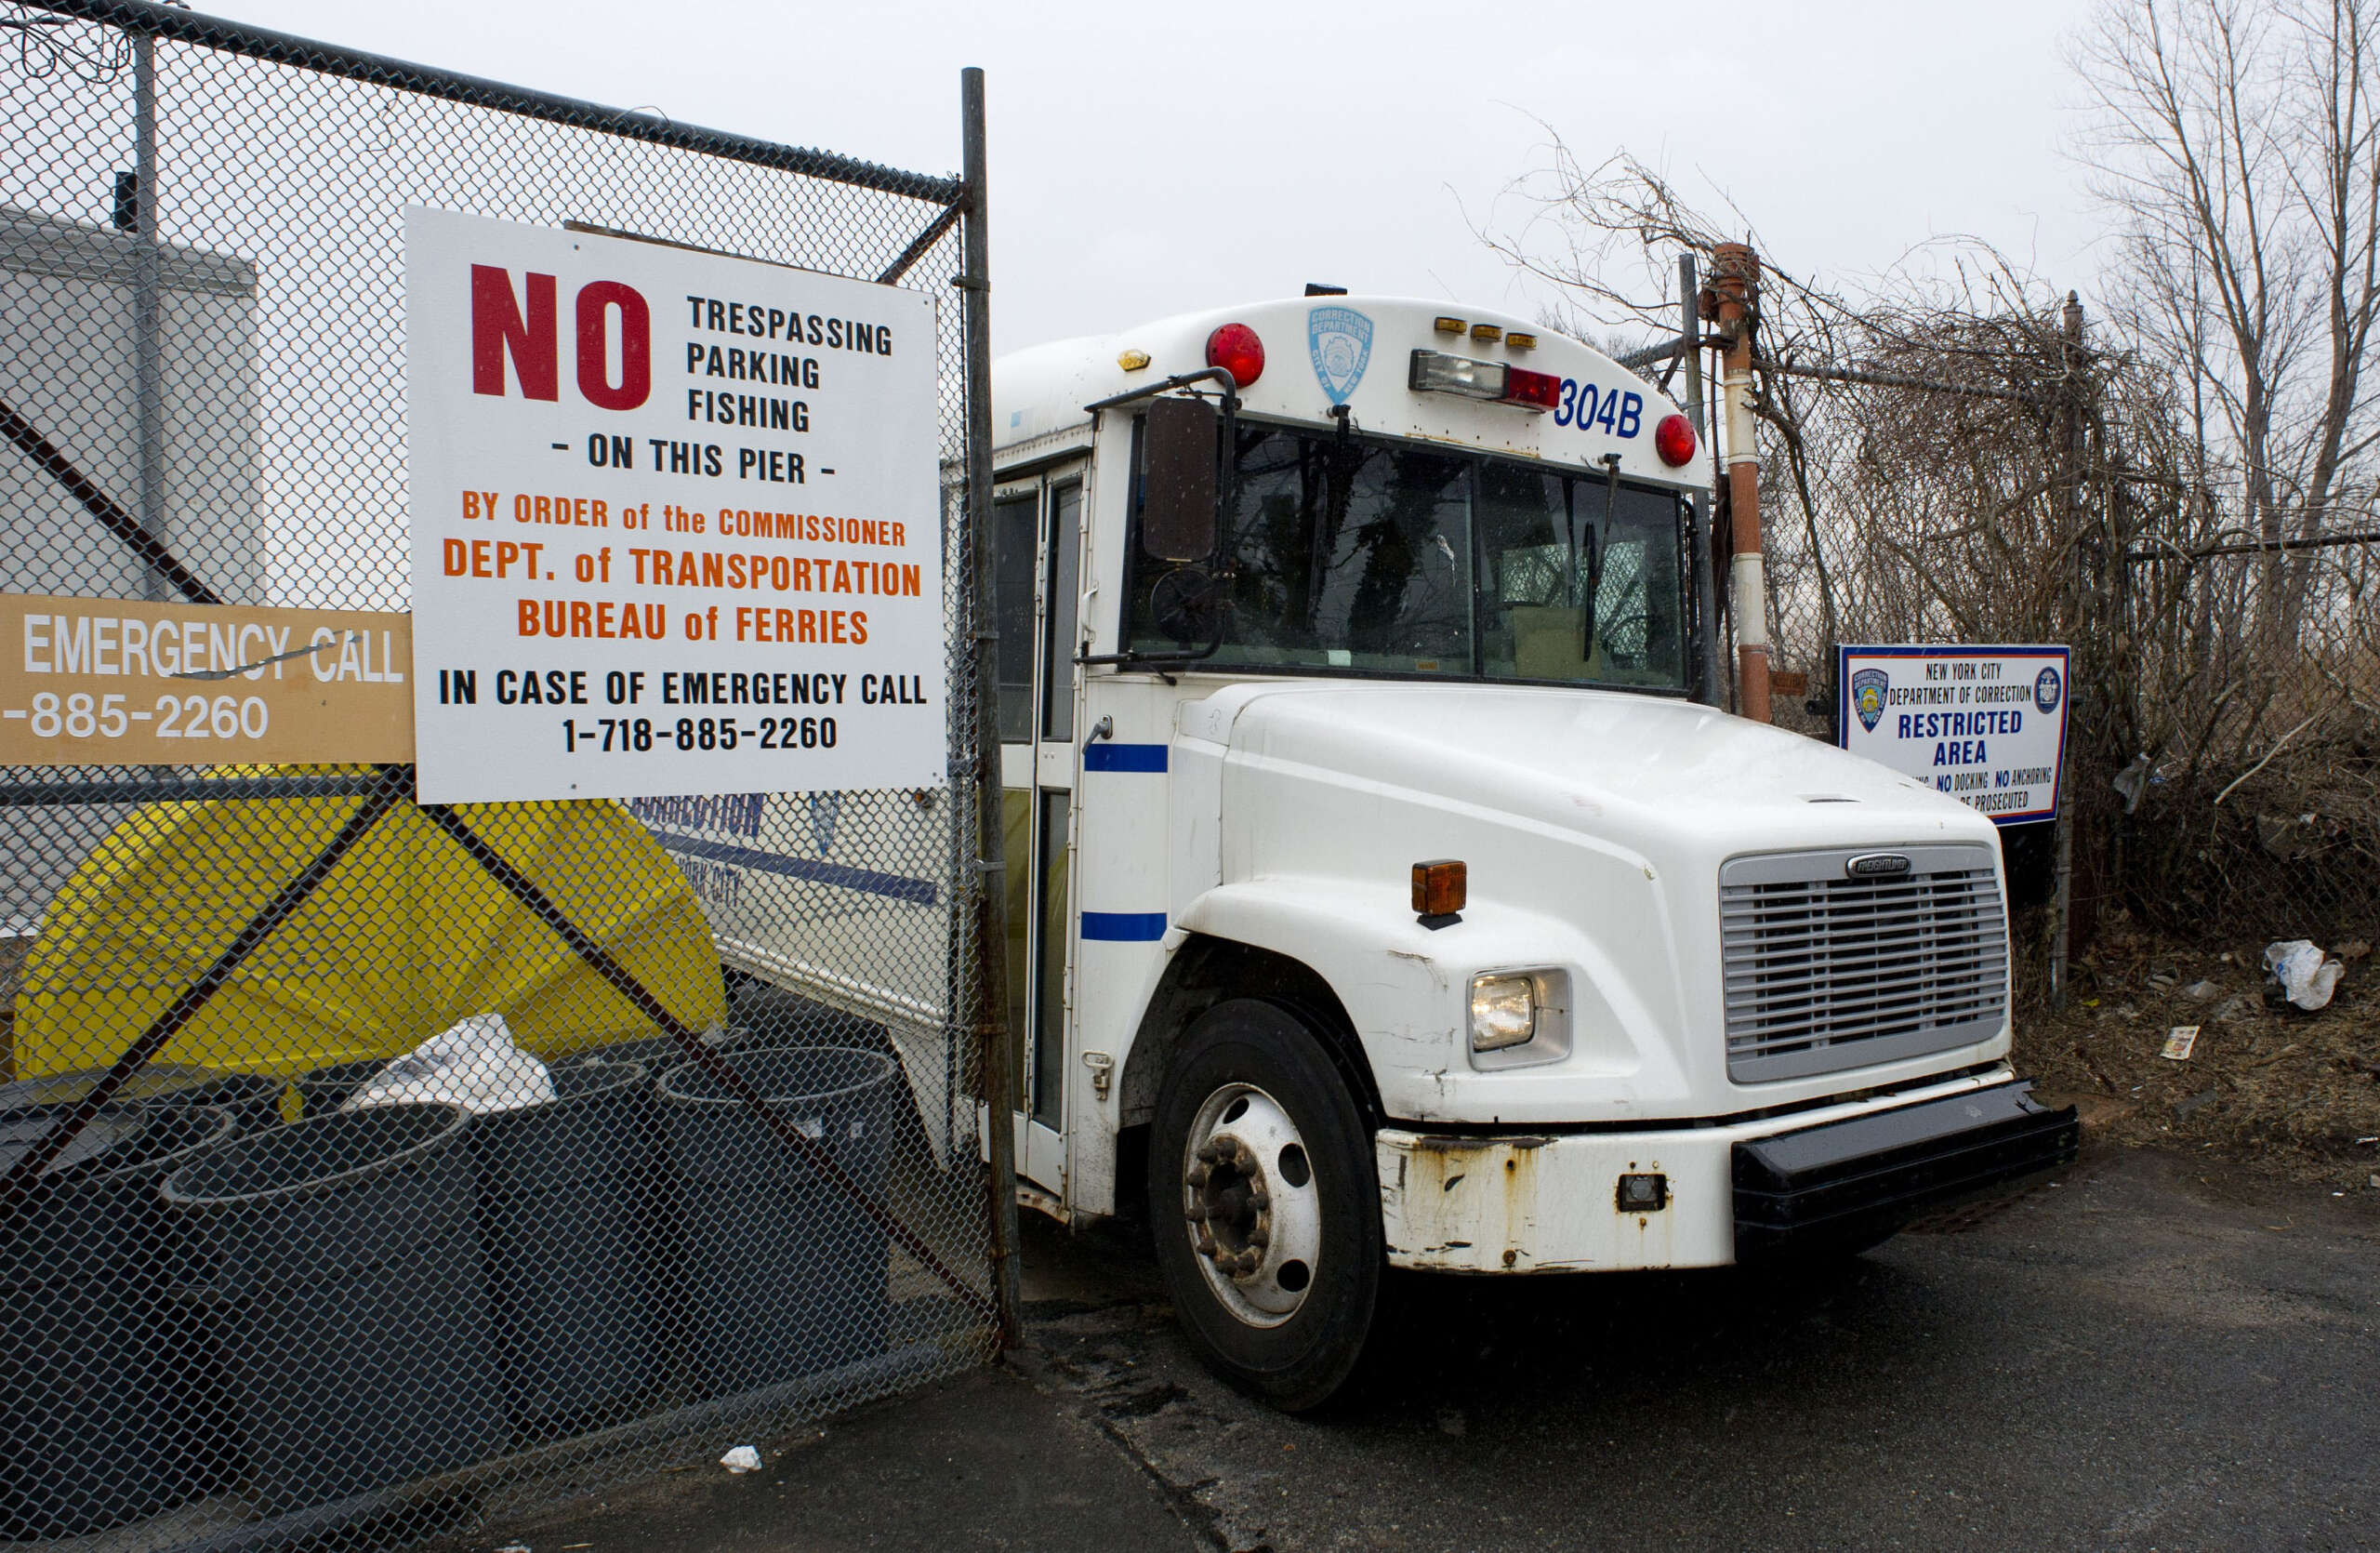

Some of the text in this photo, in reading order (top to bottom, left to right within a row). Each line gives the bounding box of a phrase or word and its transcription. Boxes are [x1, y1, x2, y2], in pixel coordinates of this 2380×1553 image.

[471, 264, 651, 410] NO
[687, 296, 891, 356] TRESPASSING
[687, 342, 818, 389] PARKING
[689, 389, 809, 432] FISHING
[1554, 378, 1643, 439] 304B
[588, 433, 632, 469] ON
[649, 439, 722, 477] THIS
[739, 448, 804, 484] PIER
[463, 491, 905, 546] BY ORDER of the COMMISSIONER
[443, 538, 920, 596] DEPT. of TRANSPORTATION
[519, 600, 867, 644] BUREAU of FERRIES
[24, 614, 403, 683] EMERGENCY CALL
[439, 670, 927, 706] IN CASE OF EMERGENCY CALL
[1926, 663, 2002, 681] NEW YORK CITY
[3, 692, 269, 738] -885-2260
[1889, 685, 2031, 705] DEPARTMENT OF CORRECTION
[562, 717, 837, 753] 1-718-885-2260
[1897, 710, 2022, 738] RESTRICTED
[1933, 740, 1987, 766] AREA
[1937, 774, 1951, 792] NO
[1954, 772, 1988, 791] DOCKING
[1995, 770, 2009, 788] NO
[2012, 766, 2052, 786] ANCHORING
[1975, 790, 2028, 812] PROSECUTED
